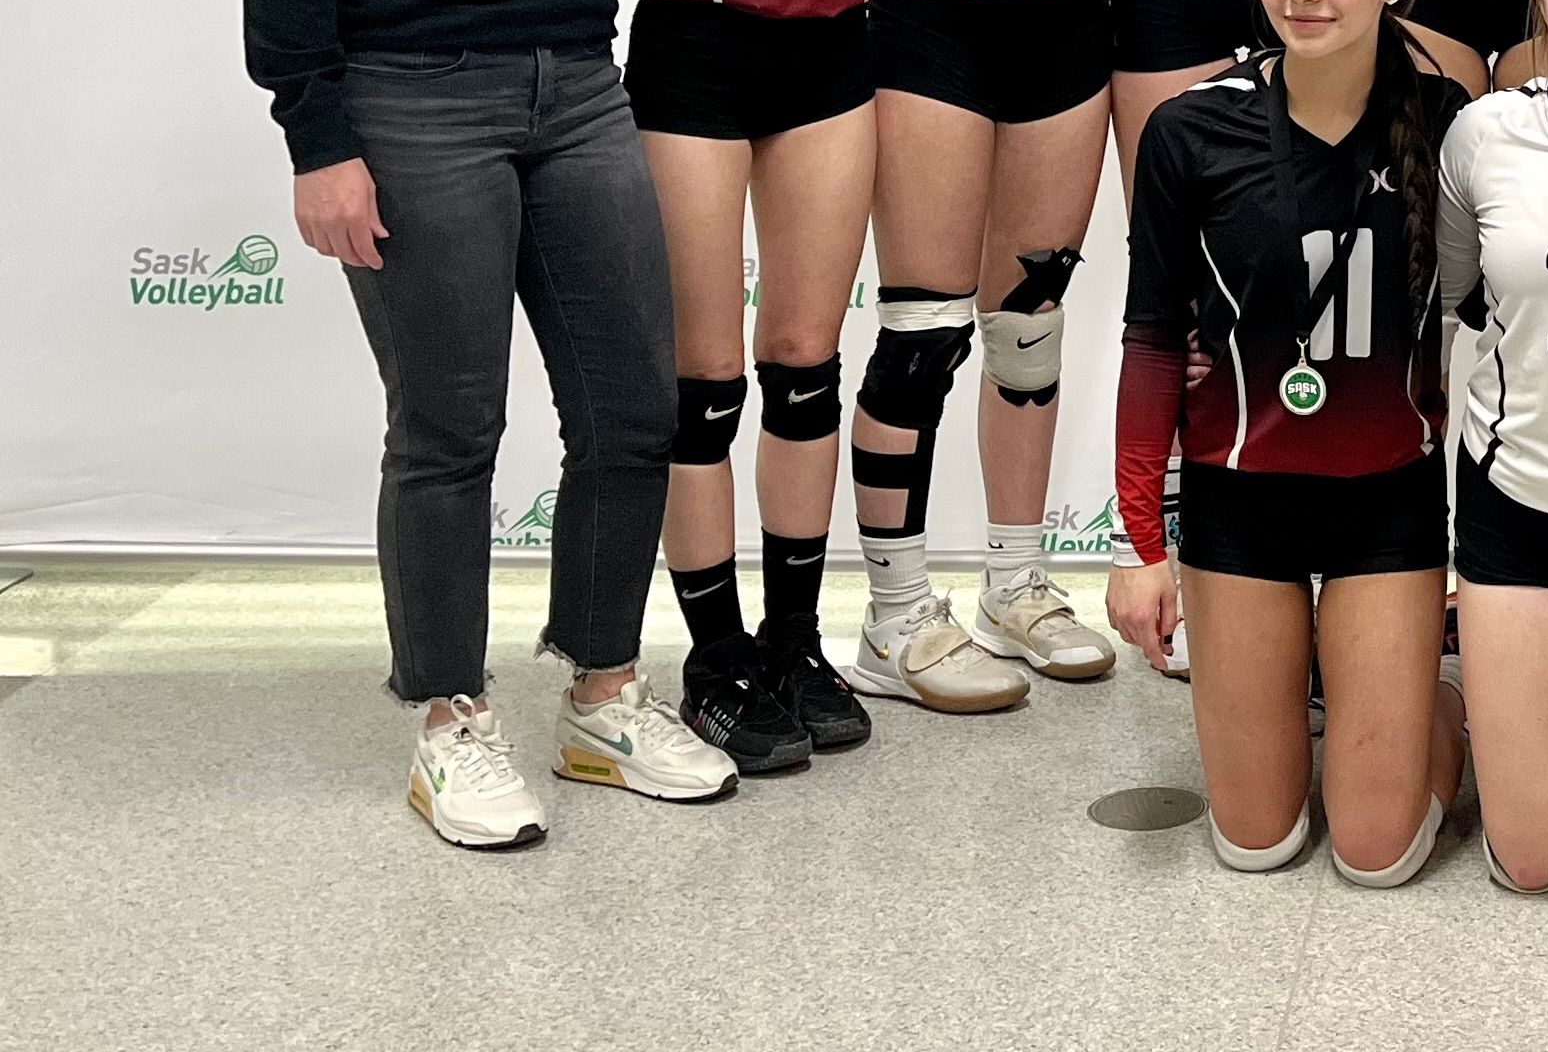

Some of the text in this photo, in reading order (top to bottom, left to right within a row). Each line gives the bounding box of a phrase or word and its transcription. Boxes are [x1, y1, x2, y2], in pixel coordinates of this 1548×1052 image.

[130, 247, 210, 276] Sask
[129, 278, 284, 311] Volleyball
[1301, 227, 1373, 361] 11
[1288, 381, 1318, 395] SASK
